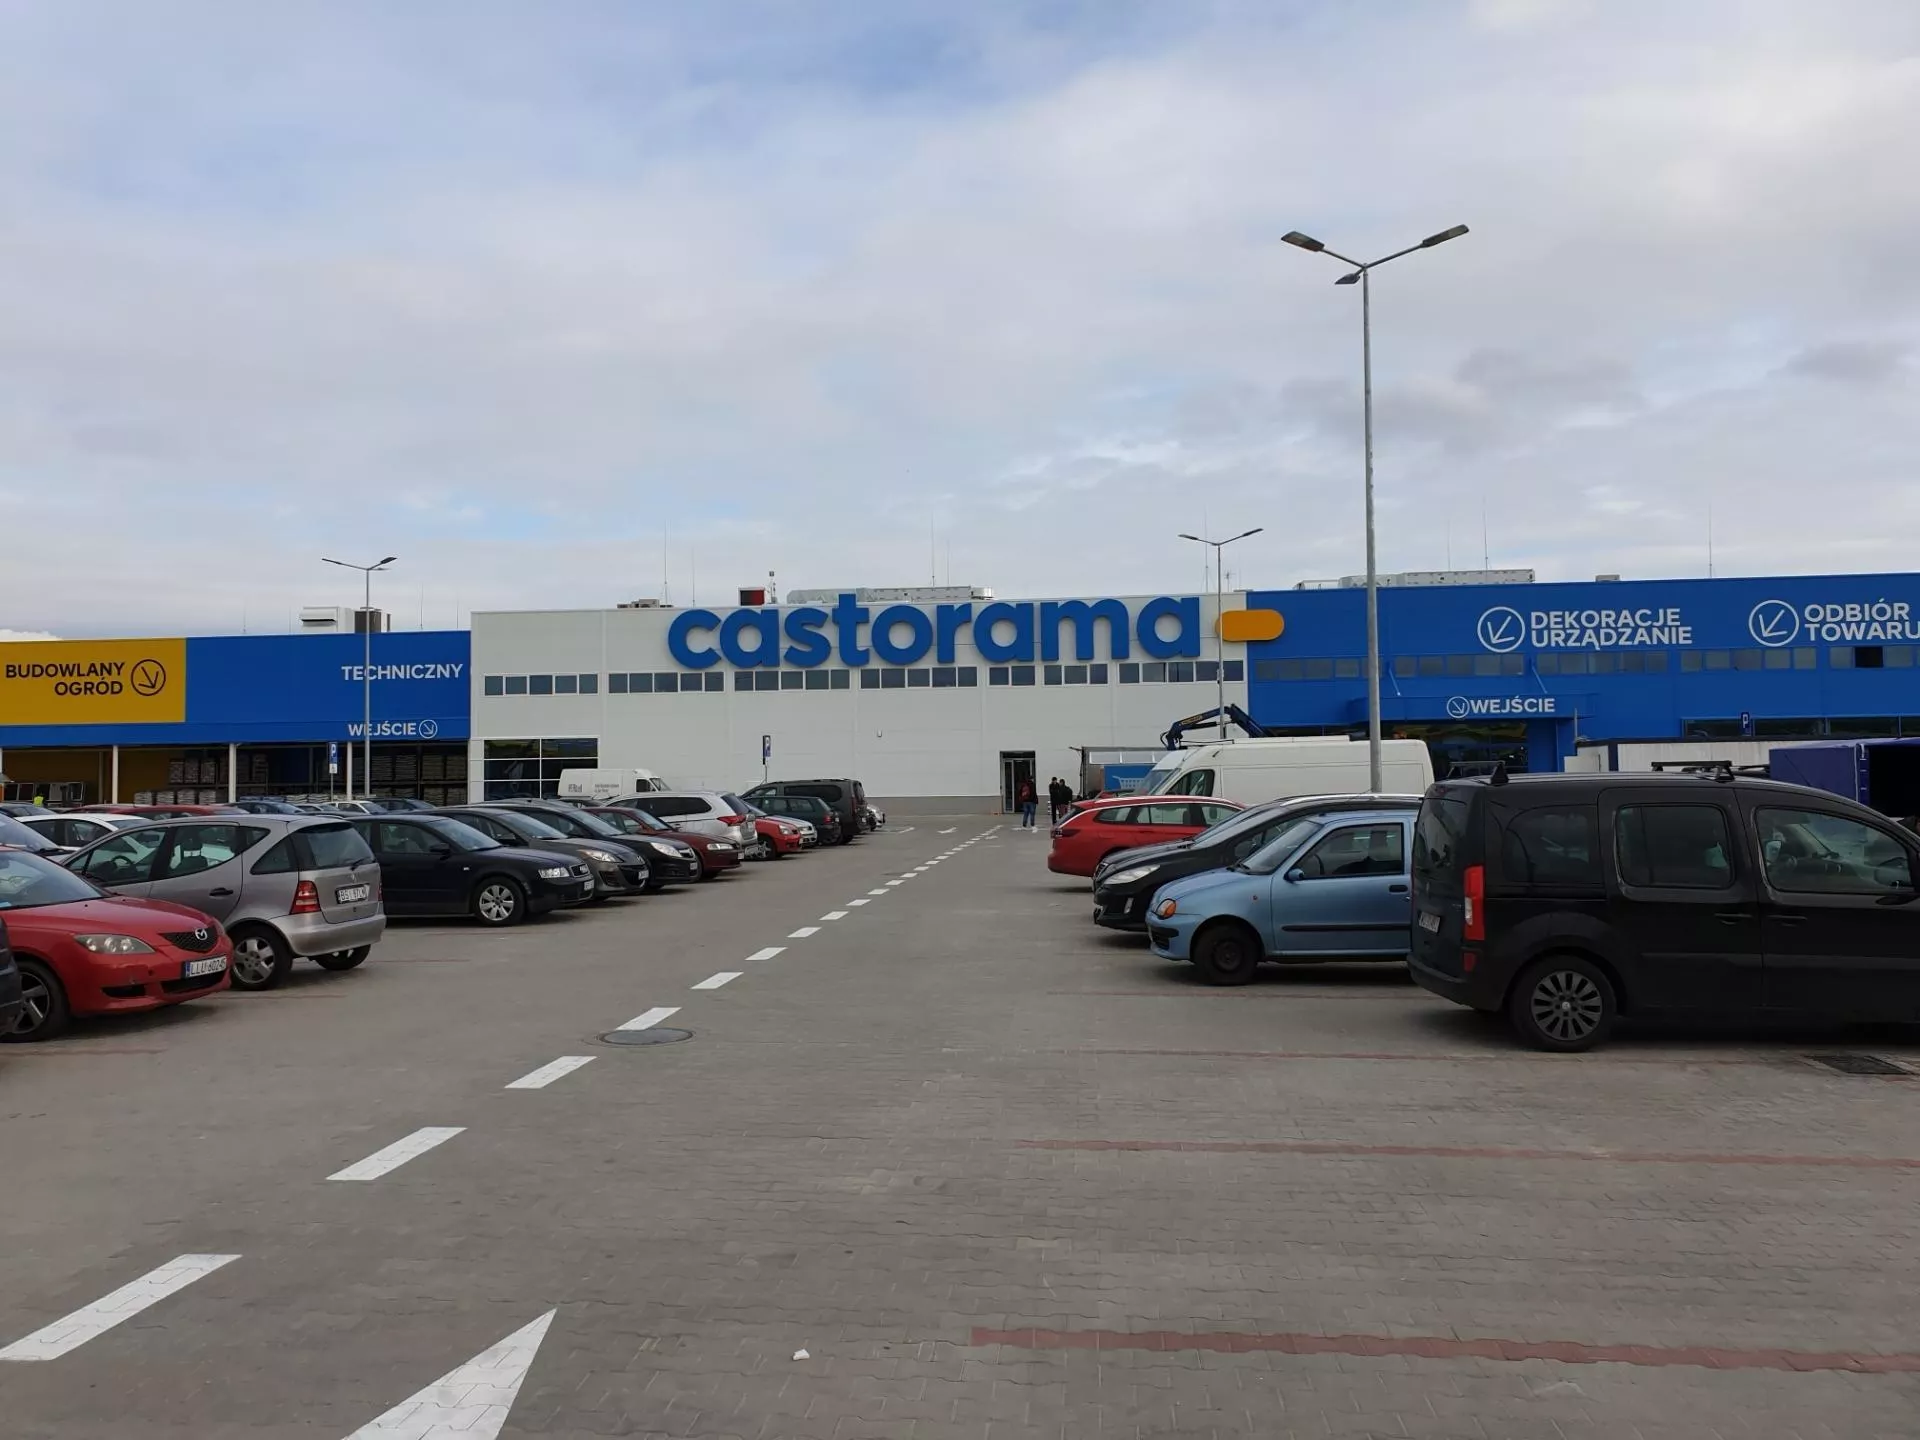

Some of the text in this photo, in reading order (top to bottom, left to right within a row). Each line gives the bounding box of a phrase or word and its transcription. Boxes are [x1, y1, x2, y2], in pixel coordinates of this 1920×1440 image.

[1531, 608, 1681, 629] DEKORACJE
[1804, 598, 1910, 622] ODBIÓR
[668, 593, 1201, 669] castorama
[1531, 627, 1692, 650] URZĄDZANIE
[1804, 621, 1920, 641] TOWARU
[5, 662, 125, 678] BUDOWLANY
[341, 664, 463, 680] TECHNICZNY
[54, 677, 123, 696] OGRÓD
[1470, 695, 1556, 714] WEJŚCIE
[348, 720, 417, 736] WEJŚCIE
[1742, 714, 1749, 729] P
